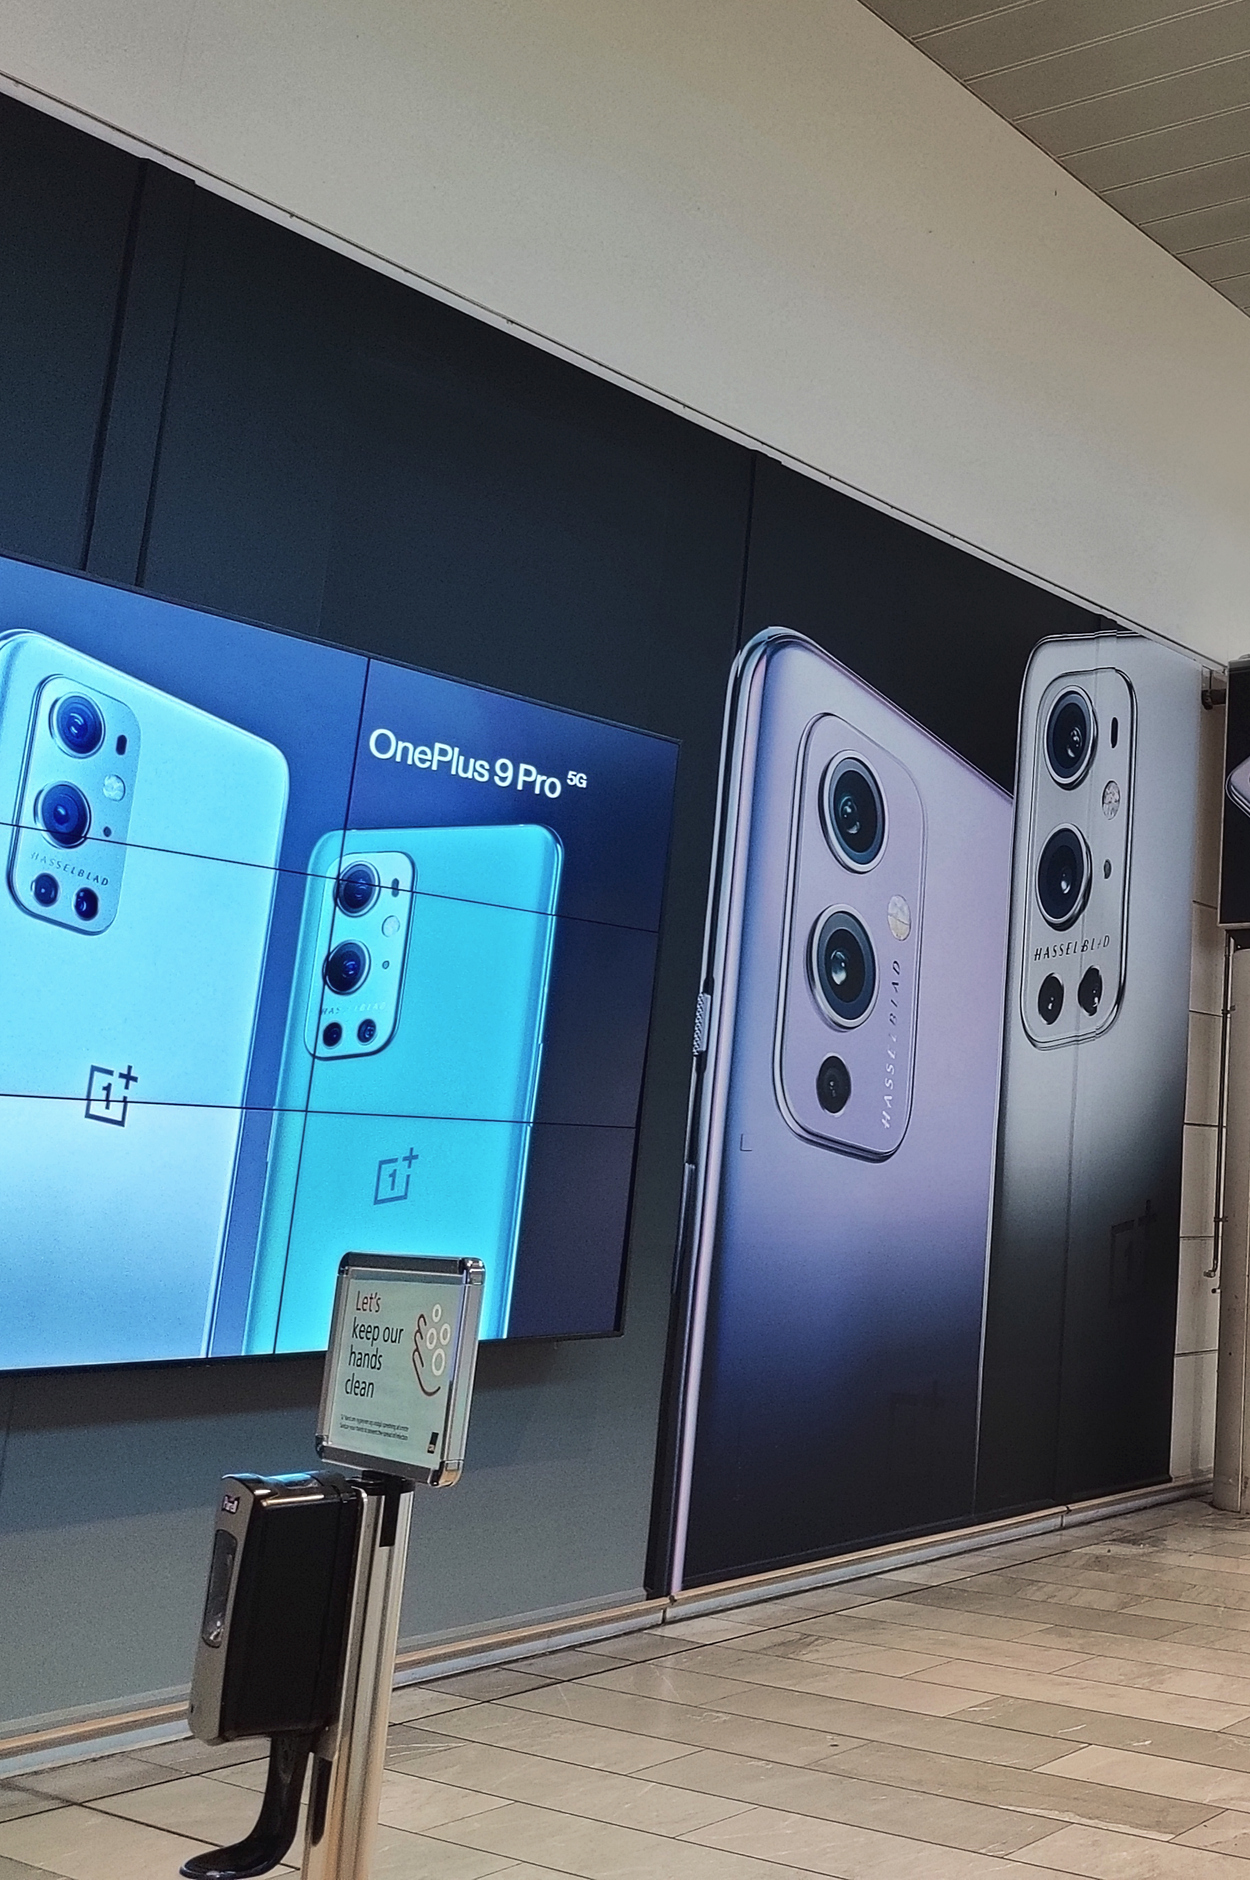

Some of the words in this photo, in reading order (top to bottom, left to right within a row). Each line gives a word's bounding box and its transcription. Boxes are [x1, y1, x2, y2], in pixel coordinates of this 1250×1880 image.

[369, 728, 490, 782] OnePlus
[494, 758, 513, 787] 9
[517, 763, 562, 798] Pro
[567, 771, 588, 788] 5G
[31, 851, 109, 886] HASSELBLAD
[355, 1290, 381, 1313] Let's
[351, 1316, 380, 1347] keep
[382, 1326, 404, 1344] our
[348, 1344, 382, 1371] hands
[344, 1372, 374, 1398] clean
